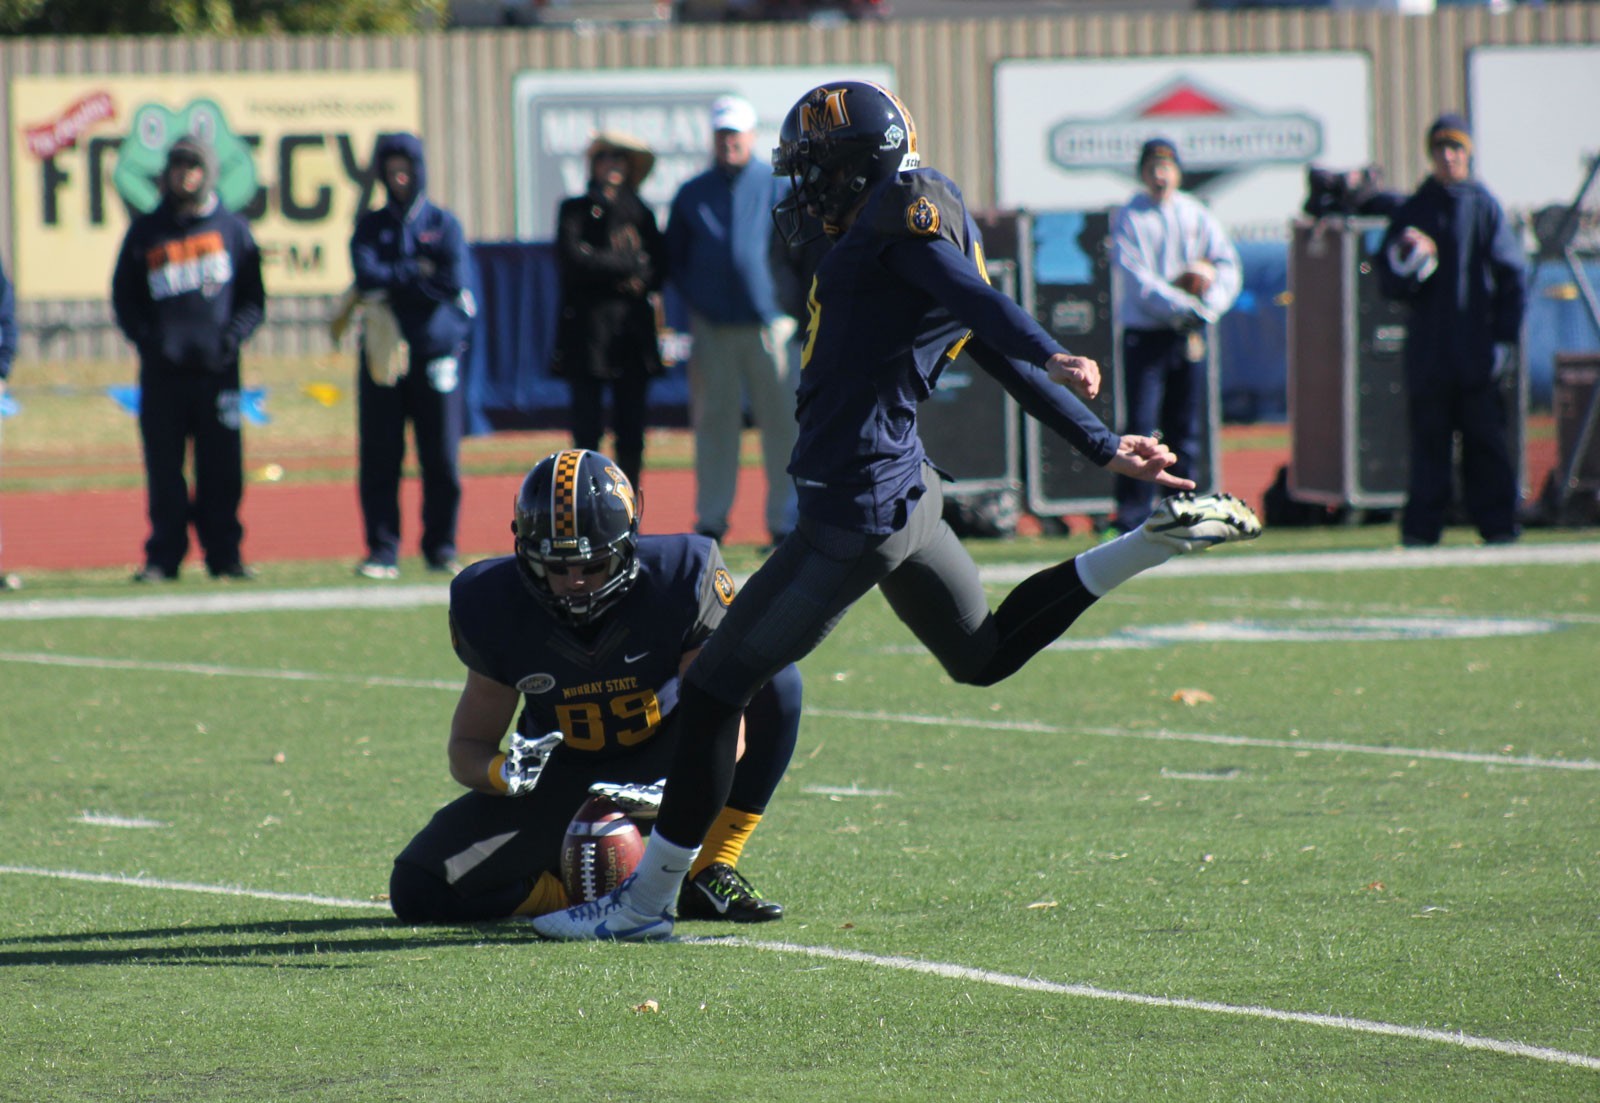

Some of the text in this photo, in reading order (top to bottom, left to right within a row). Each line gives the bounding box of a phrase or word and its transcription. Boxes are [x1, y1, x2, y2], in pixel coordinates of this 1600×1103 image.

[562, 677, 639, 699] MURRAY STATE
[555, 688, 662, 752] 89
